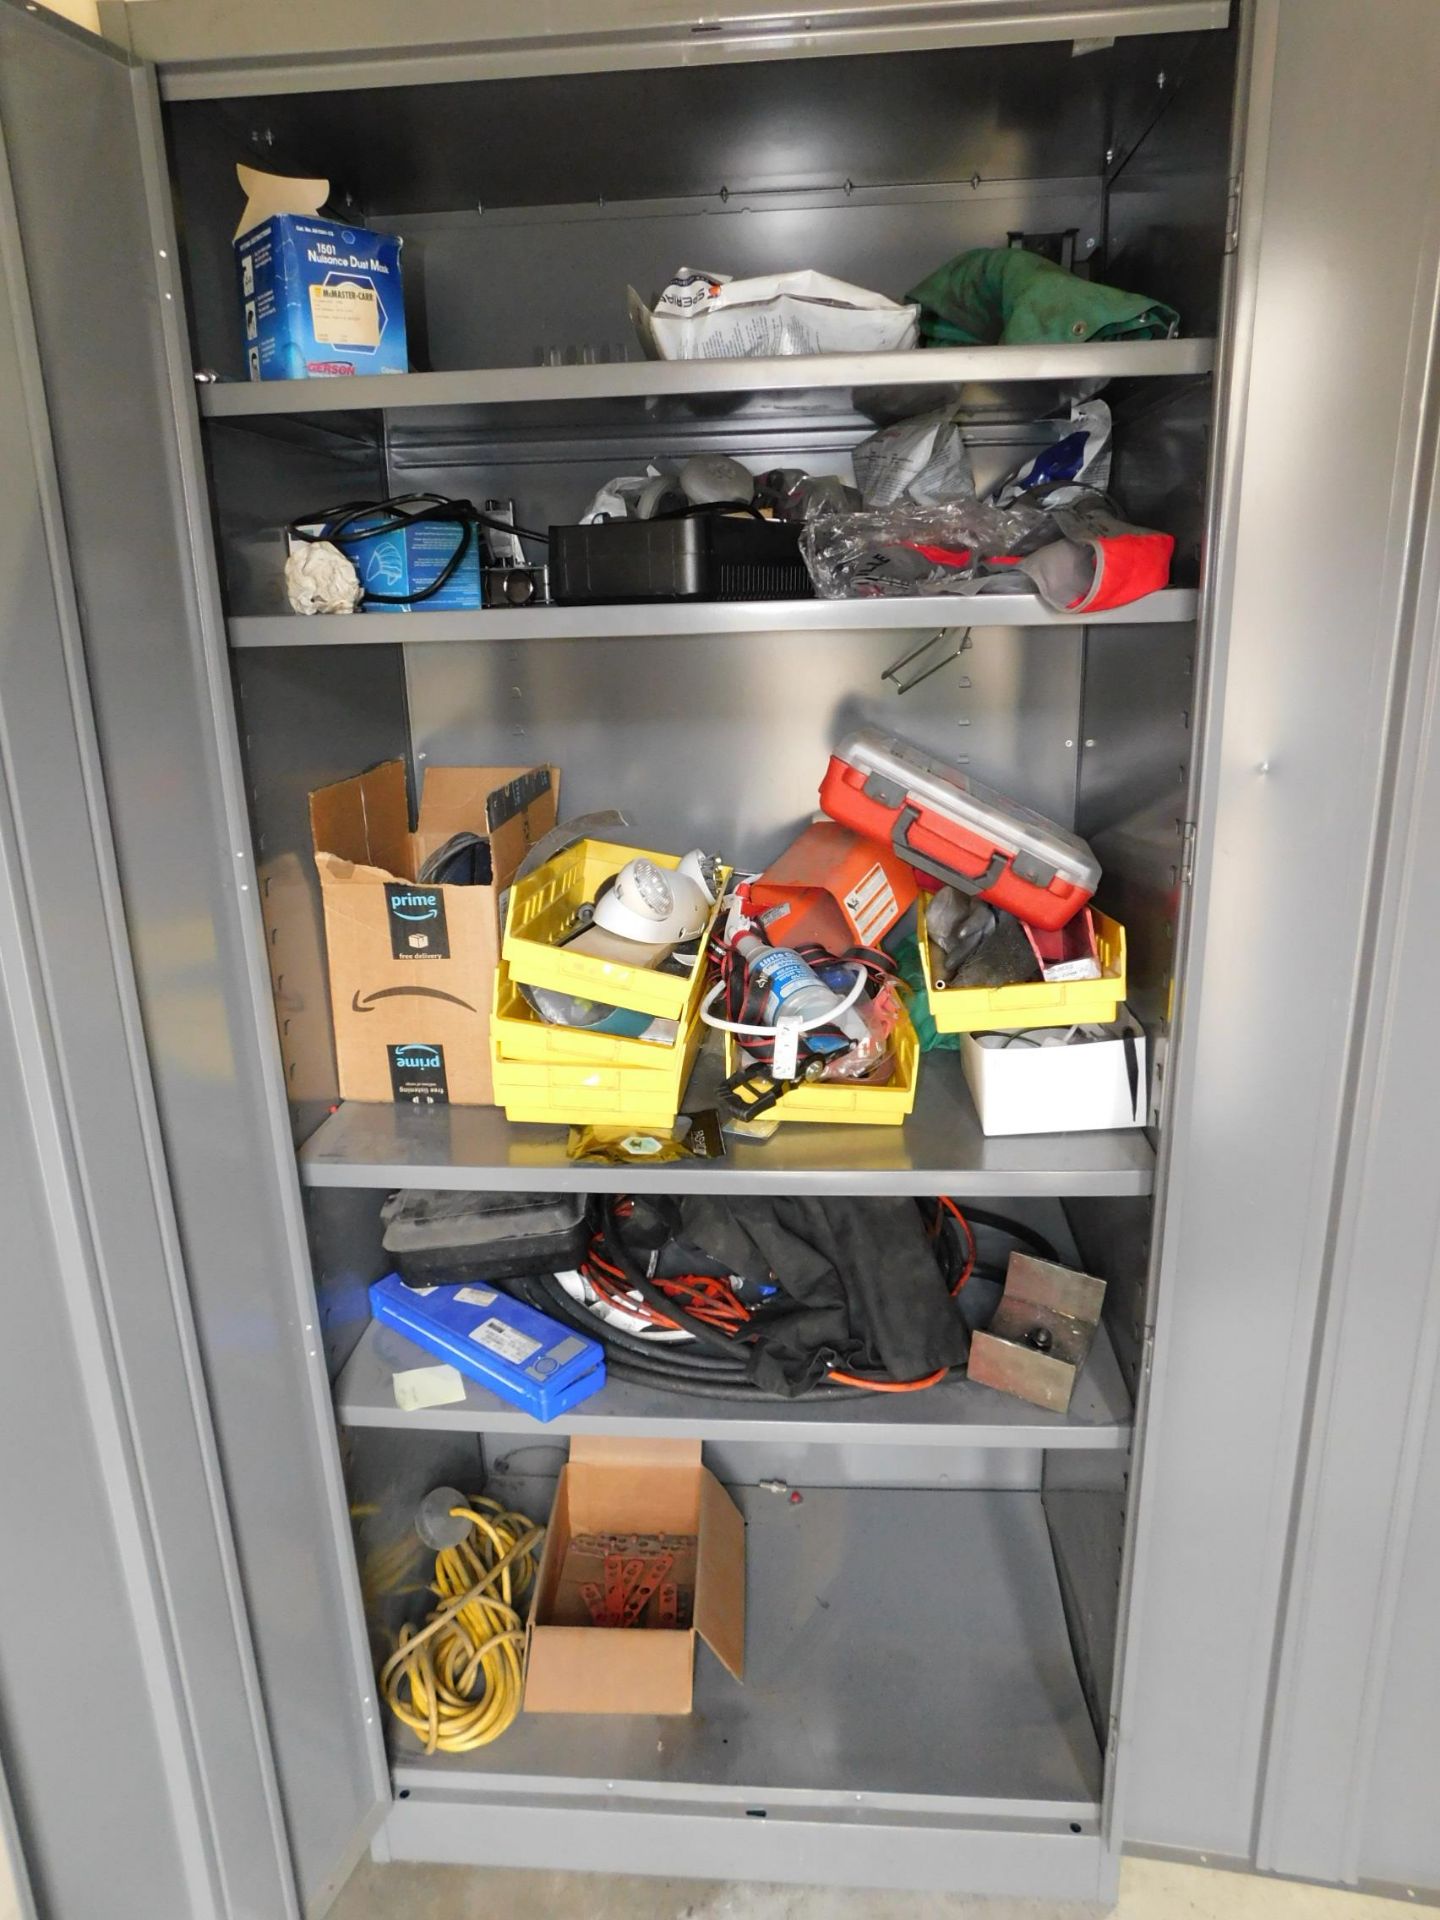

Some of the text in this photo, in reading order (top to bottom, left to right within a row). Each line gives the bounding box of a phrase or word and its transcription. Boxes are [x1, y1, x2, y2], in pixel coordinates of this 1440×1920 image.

[316, 243, 337, 255] 1501
[307, 249, 348, 267] Nuisance
[350, 255, 369, 270] Dust
[391, 892, 437, 910] prime
[396, 1055, 441, 1071] prime
